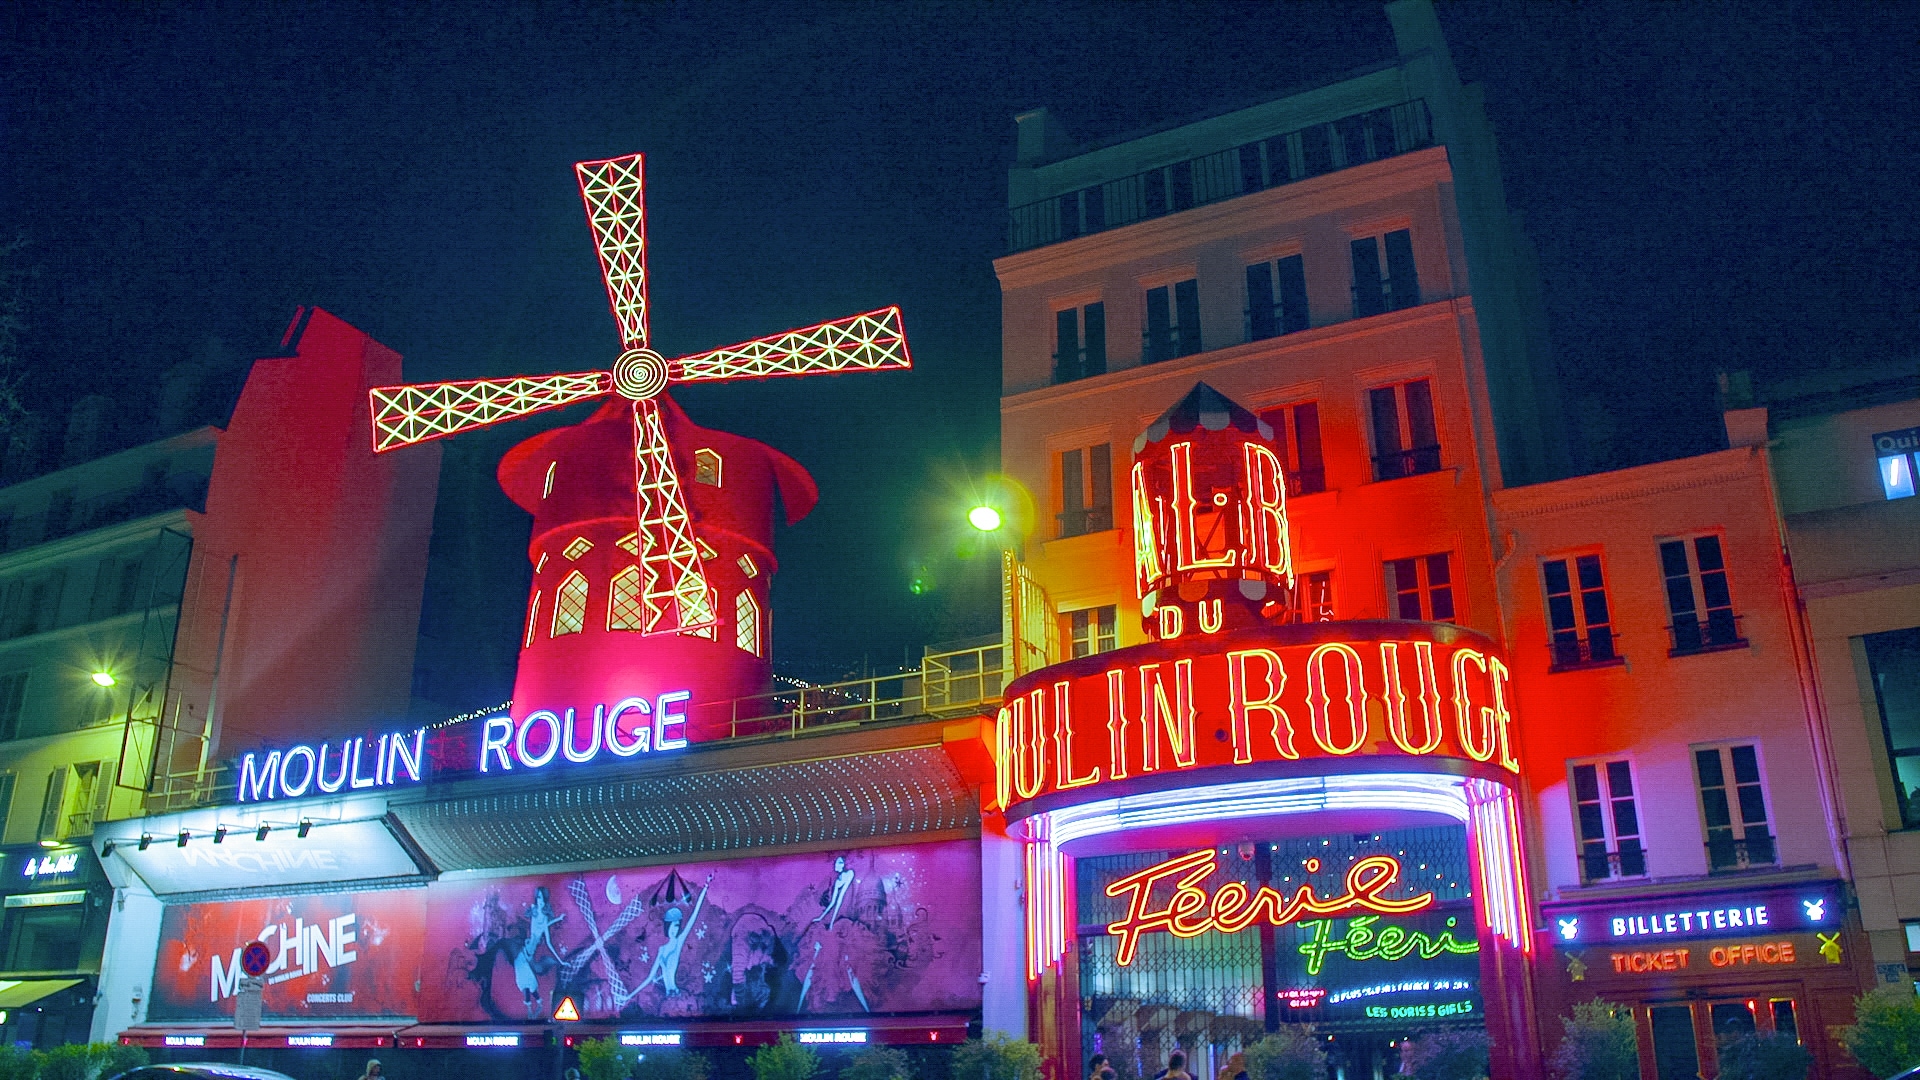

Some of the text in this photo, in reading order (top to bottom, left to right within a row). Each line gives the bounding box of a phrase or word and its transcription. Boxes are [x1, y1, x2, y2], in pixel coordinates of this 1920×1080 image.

[1876, 430, 1920, 451] Qui
[1159, 598, 1224, 640] DU
[995, 641, 1520, 813] OULIN ROUGE
[238, 690, 691, 802] MOULIN ROUGE
[1612, 905, 1769, 937] BILLETTERIE
[1297, 915, 1480, 975] Féeri
[1611, 941, 1797, 974] TICKET OFFICE
[306, 992, 353, 1003] CONCERTS CLUB
[1365, 1006, 1388, 1018] LES
[1390, 1004, 1436, 1019] DORISS
[621, 1034, 680, 1046] MOULIN ROUGE
